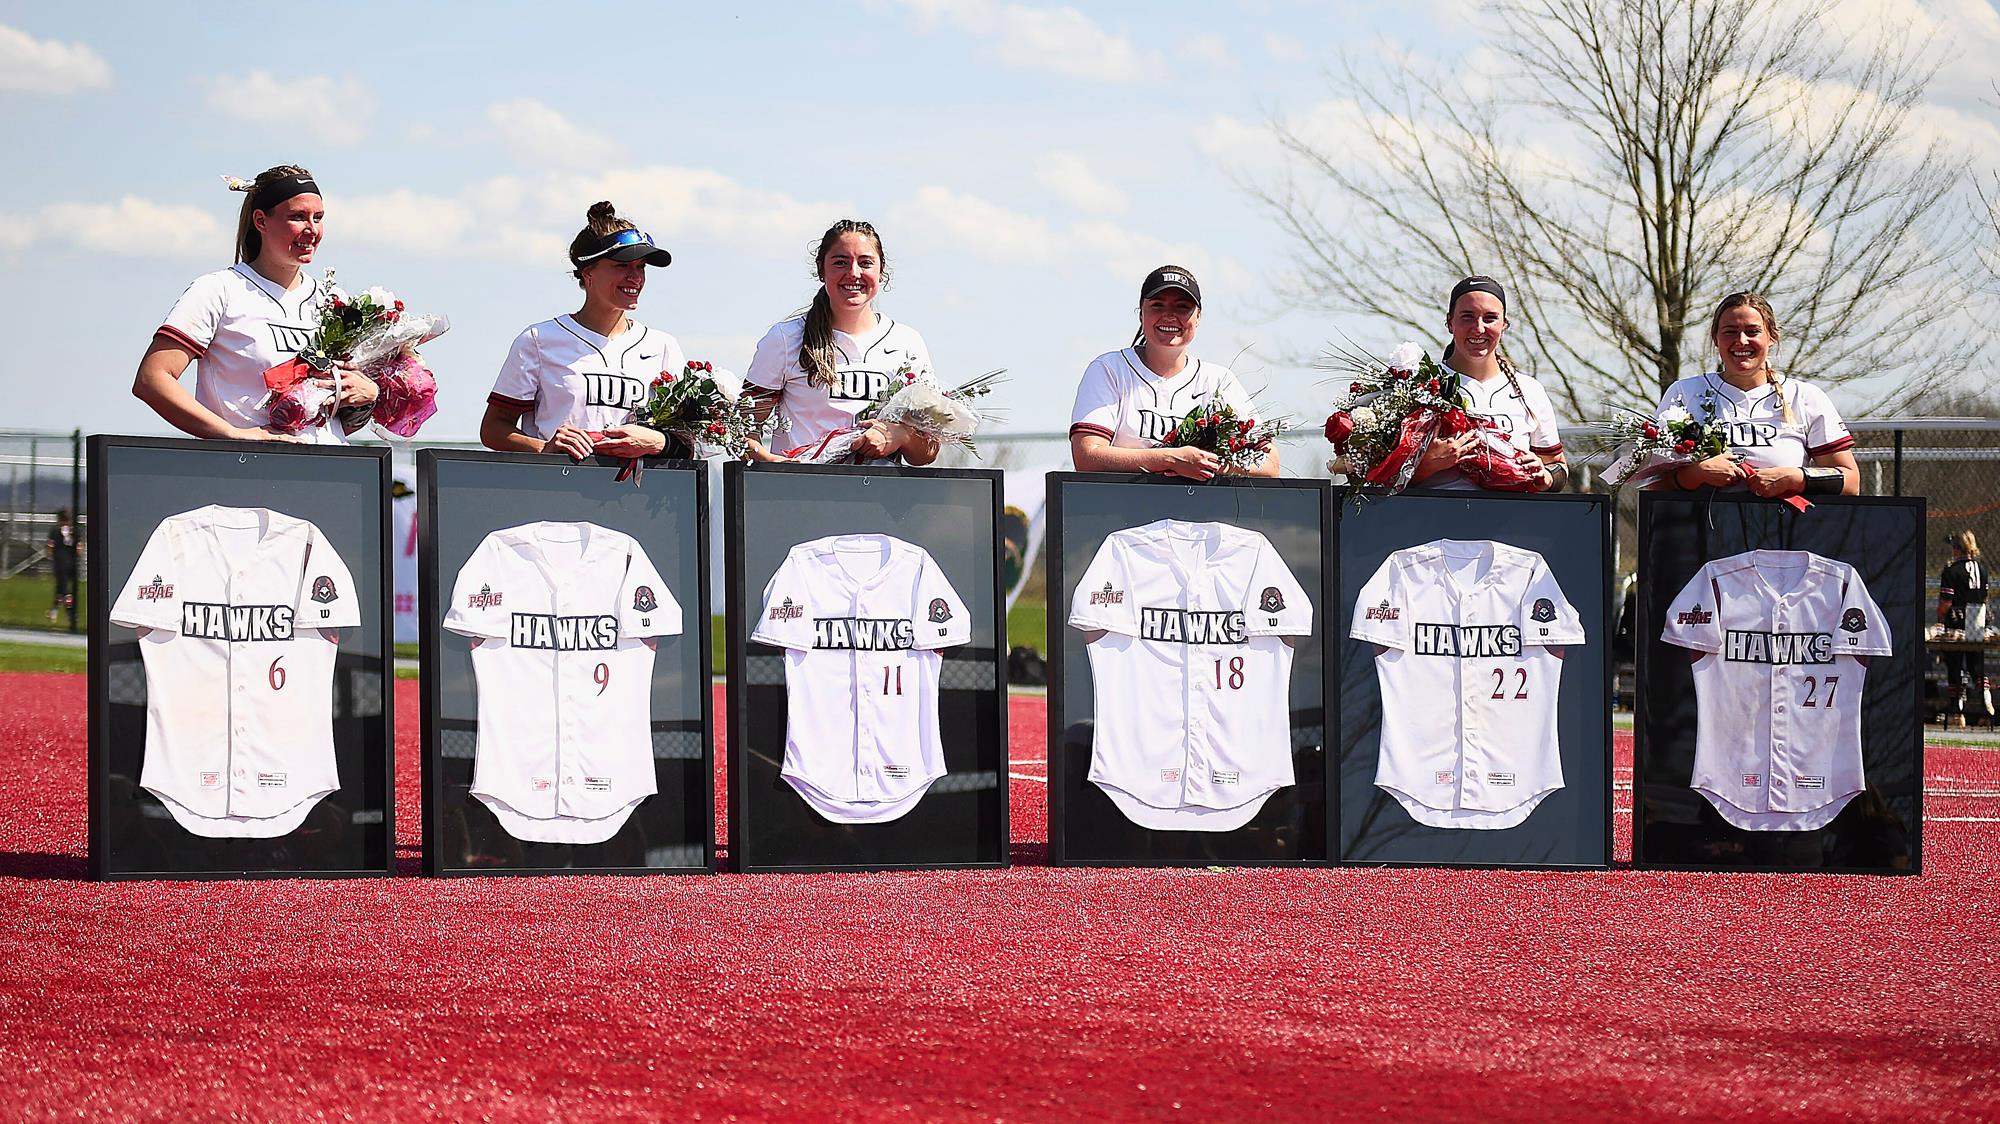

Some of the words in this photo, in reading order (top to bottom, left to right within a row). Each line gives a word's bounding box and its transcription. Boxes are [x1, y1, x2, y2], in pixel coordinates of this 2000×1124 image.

[1162, 273, 1180, 282] IUP
[582, 374, 644, 410] IUP
[182, 601, 294, 642] HAWKS
[511, 612, 618, 651] HAWKS
[812, 617, 915, 651] HAWKS
[1141, 607, 1248, 644] HAWKS
[1415, 622, 1522, 658] HAWKS
[1725, 630, 1835, 665] HAWKS
[269, 656, 286, 690] 6
[594, 663, 609, 697] 9
[883, 665, 902, 695] 11
[1215, 656, 1245, 690] 18
[1491, 667, 1529, 700] 22
[1803, 676, 1840, 708] 27
